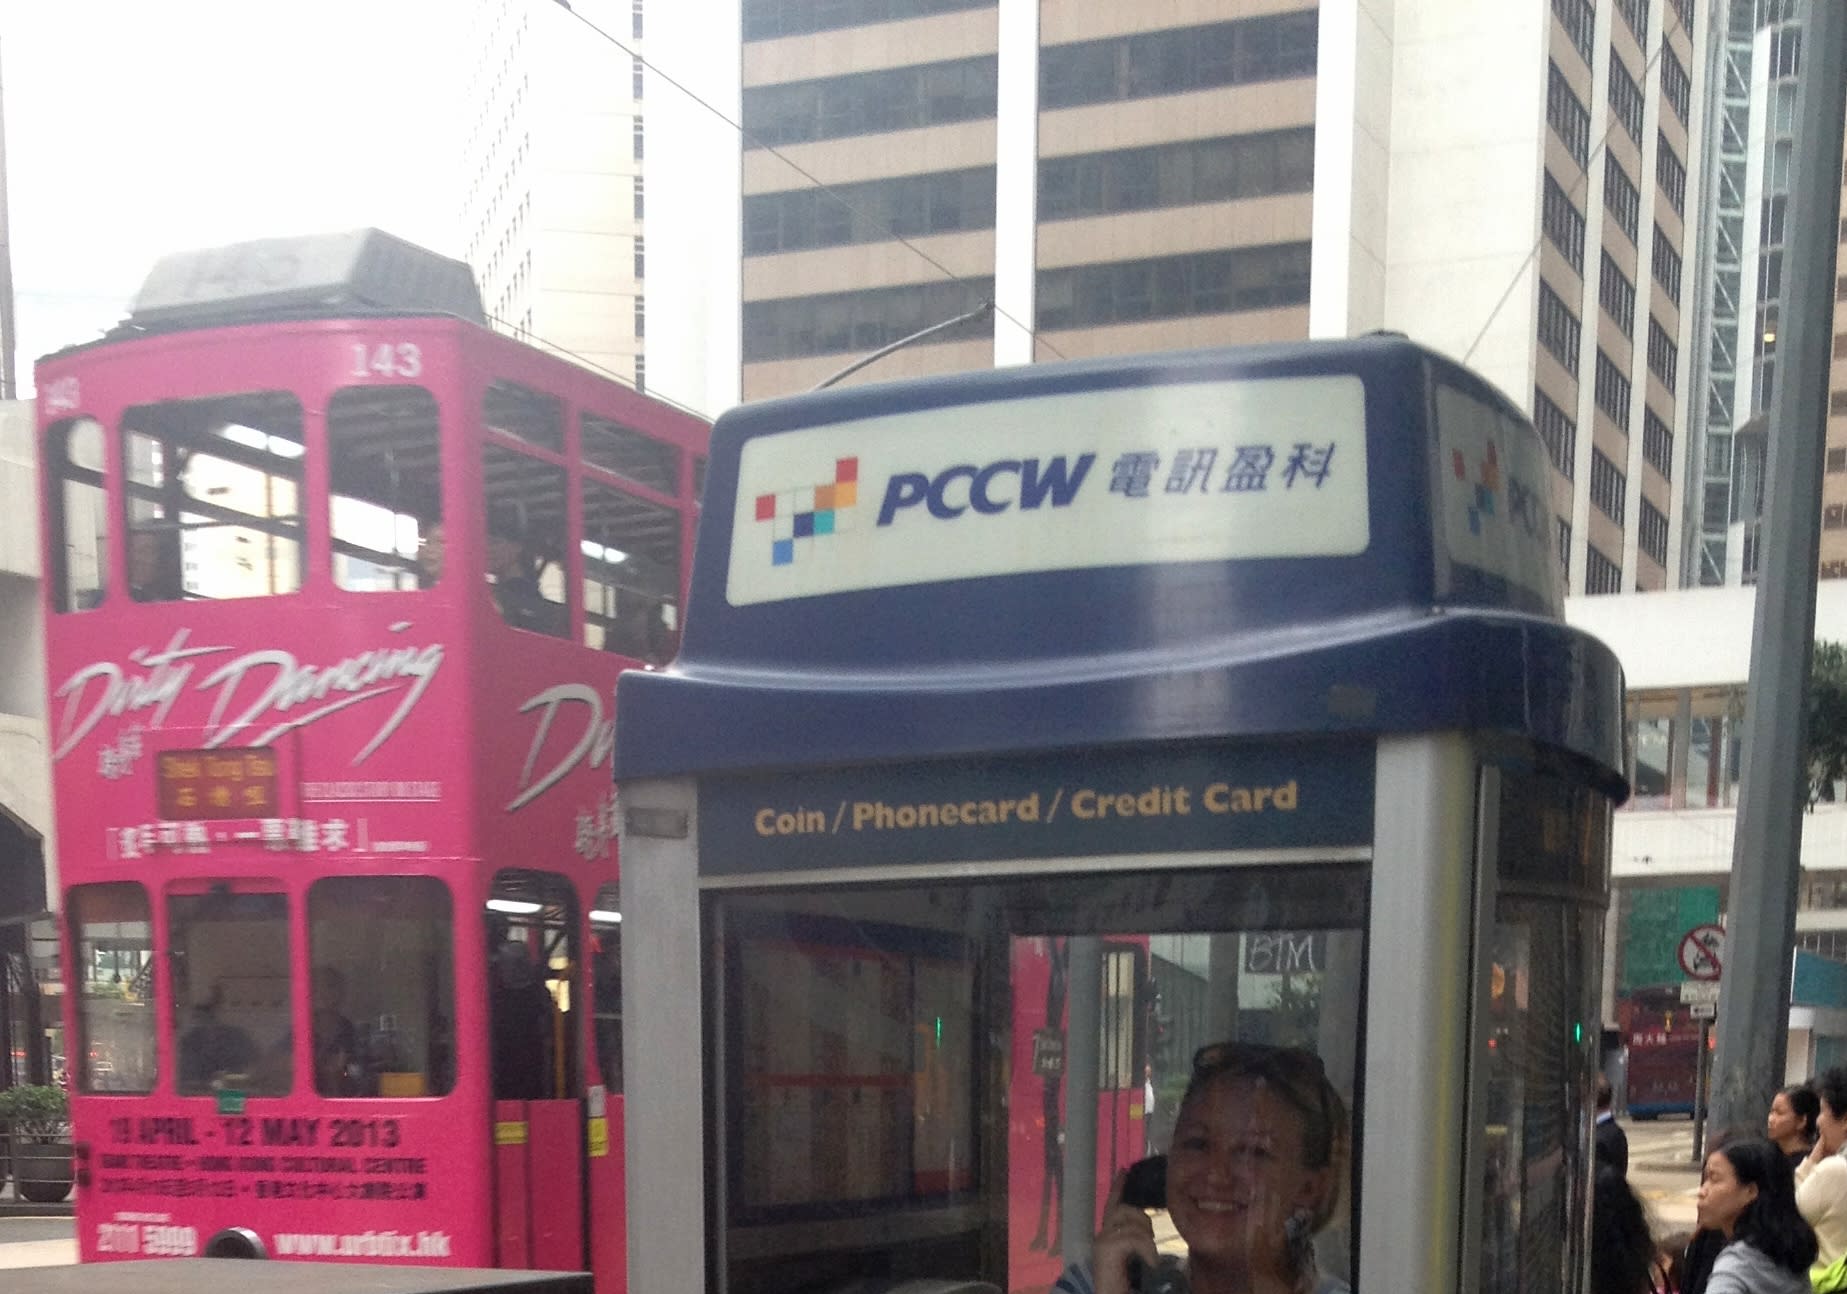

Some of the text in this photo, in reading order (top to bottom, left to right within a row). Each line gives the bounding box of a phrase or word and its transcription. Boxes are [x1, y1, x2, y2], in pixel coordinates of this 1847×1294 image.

[353, 343, 422, 377] 143
[876, 442, 1336, 527] PCCW 電訊盈科
[54, 628, 235, 762] Dirty
[195, 622, 444, 767] Dancing
[754, 807, 825, 836] Coin
[852, 794, 1040, 830] Phonecard
[1071, 785, 1191, 820] Credit
[1204, 780, 1298, 813] Card
[139, 1118, 199, 1145] APRIL
[223, 1118, 254, 1146] 12
[262, 1118, 319, 1147] MAY
[330, 1119, 401, 1148] 2013
